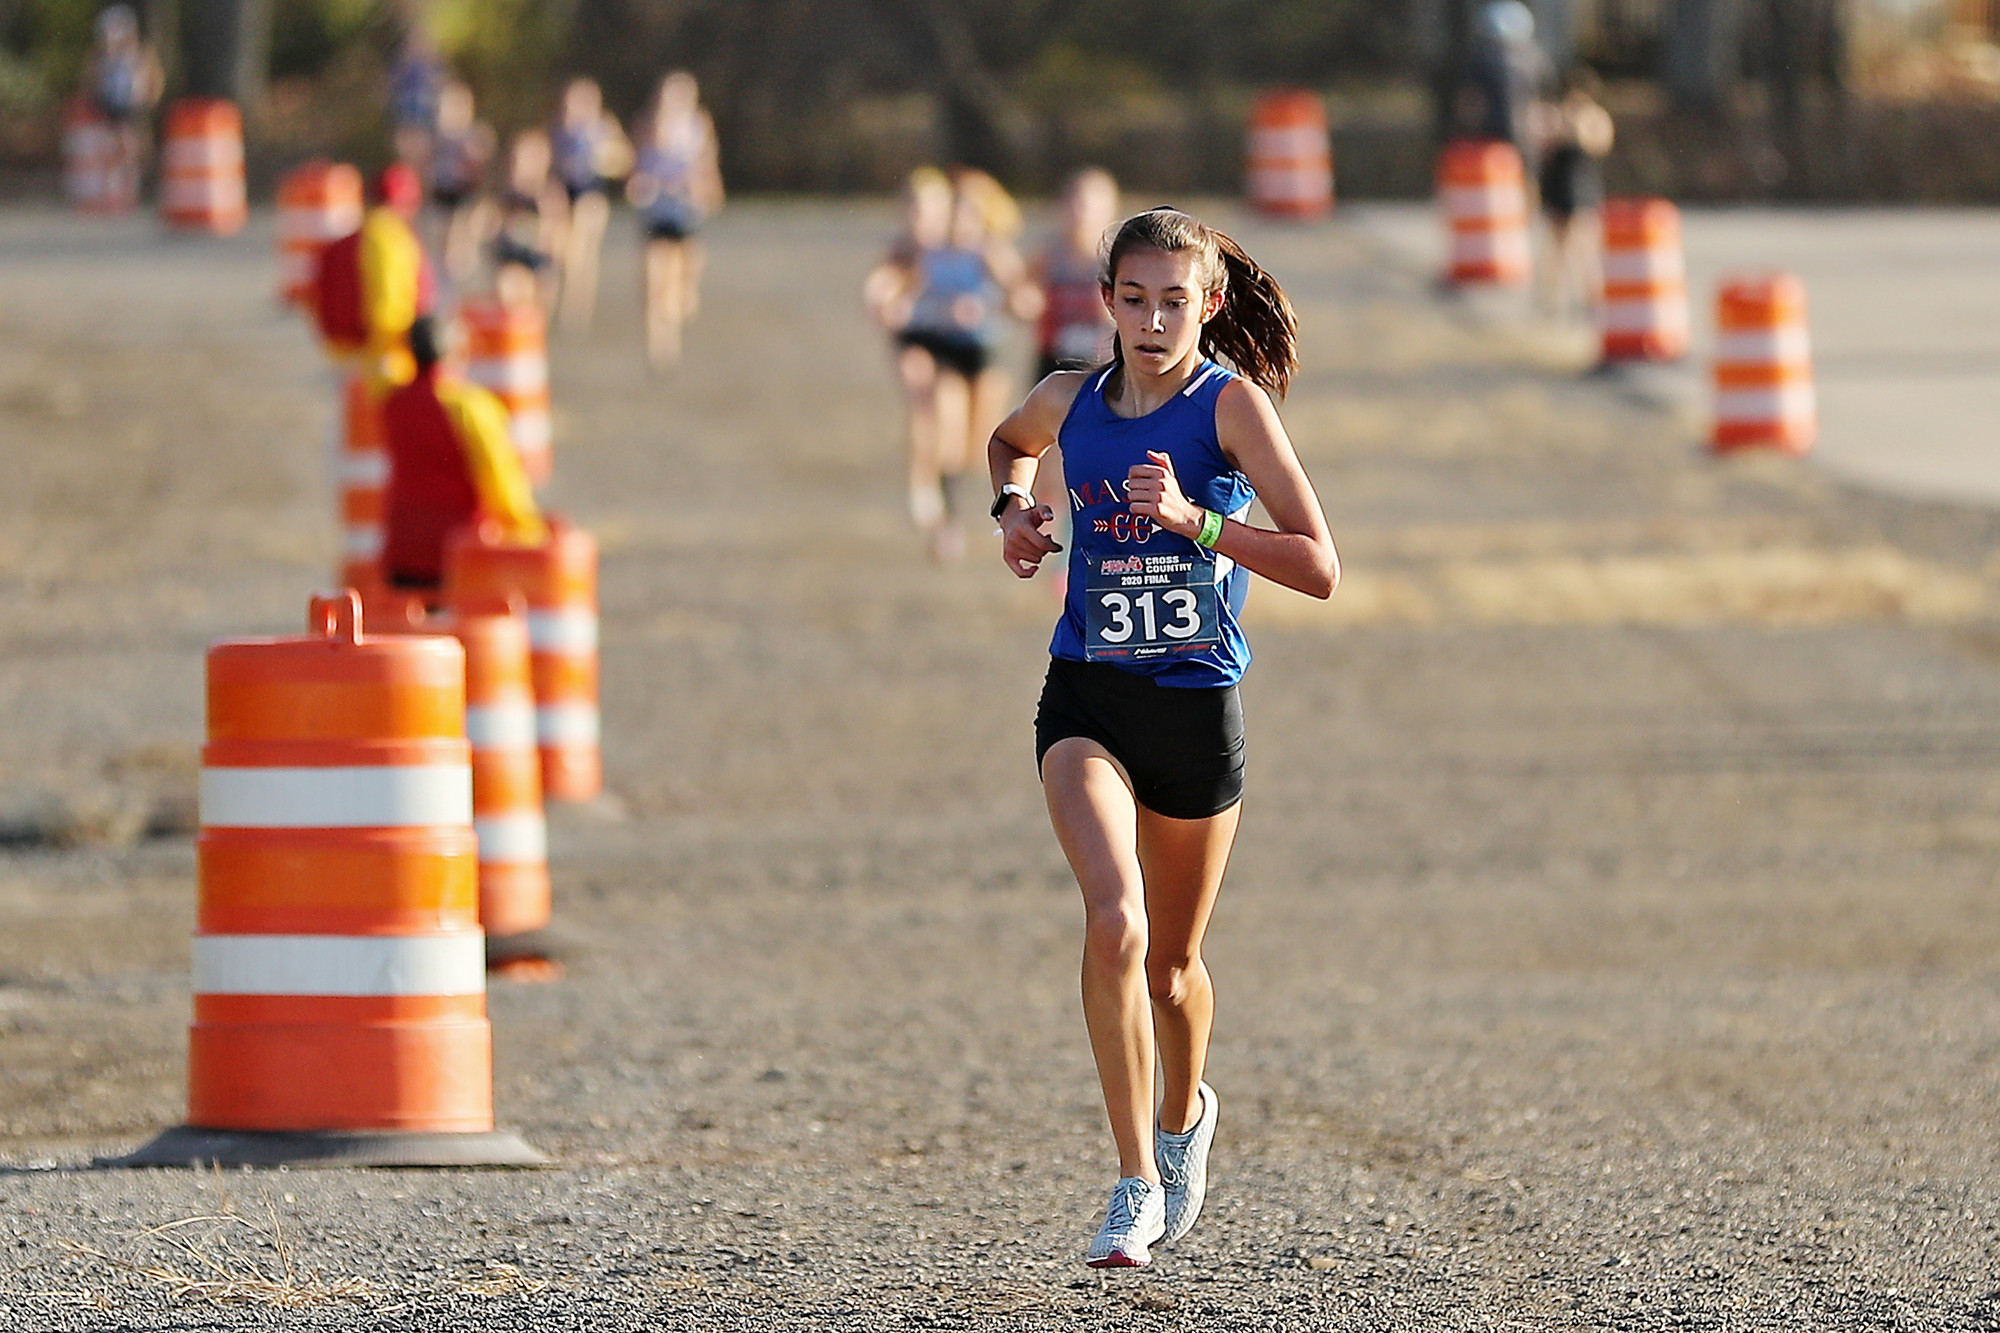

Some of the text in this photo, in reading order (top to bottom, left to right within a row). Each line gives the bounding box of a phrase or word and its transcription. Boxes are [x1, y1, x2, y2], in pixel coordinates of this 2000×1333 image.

[1145, 556, 1179, 565] CROSS
[1146, 563, 1192, 573] COUNTRY
[1121, 575, 1171, 586] 2020 FINAL
[1100, 589, 1201, 643] 313
